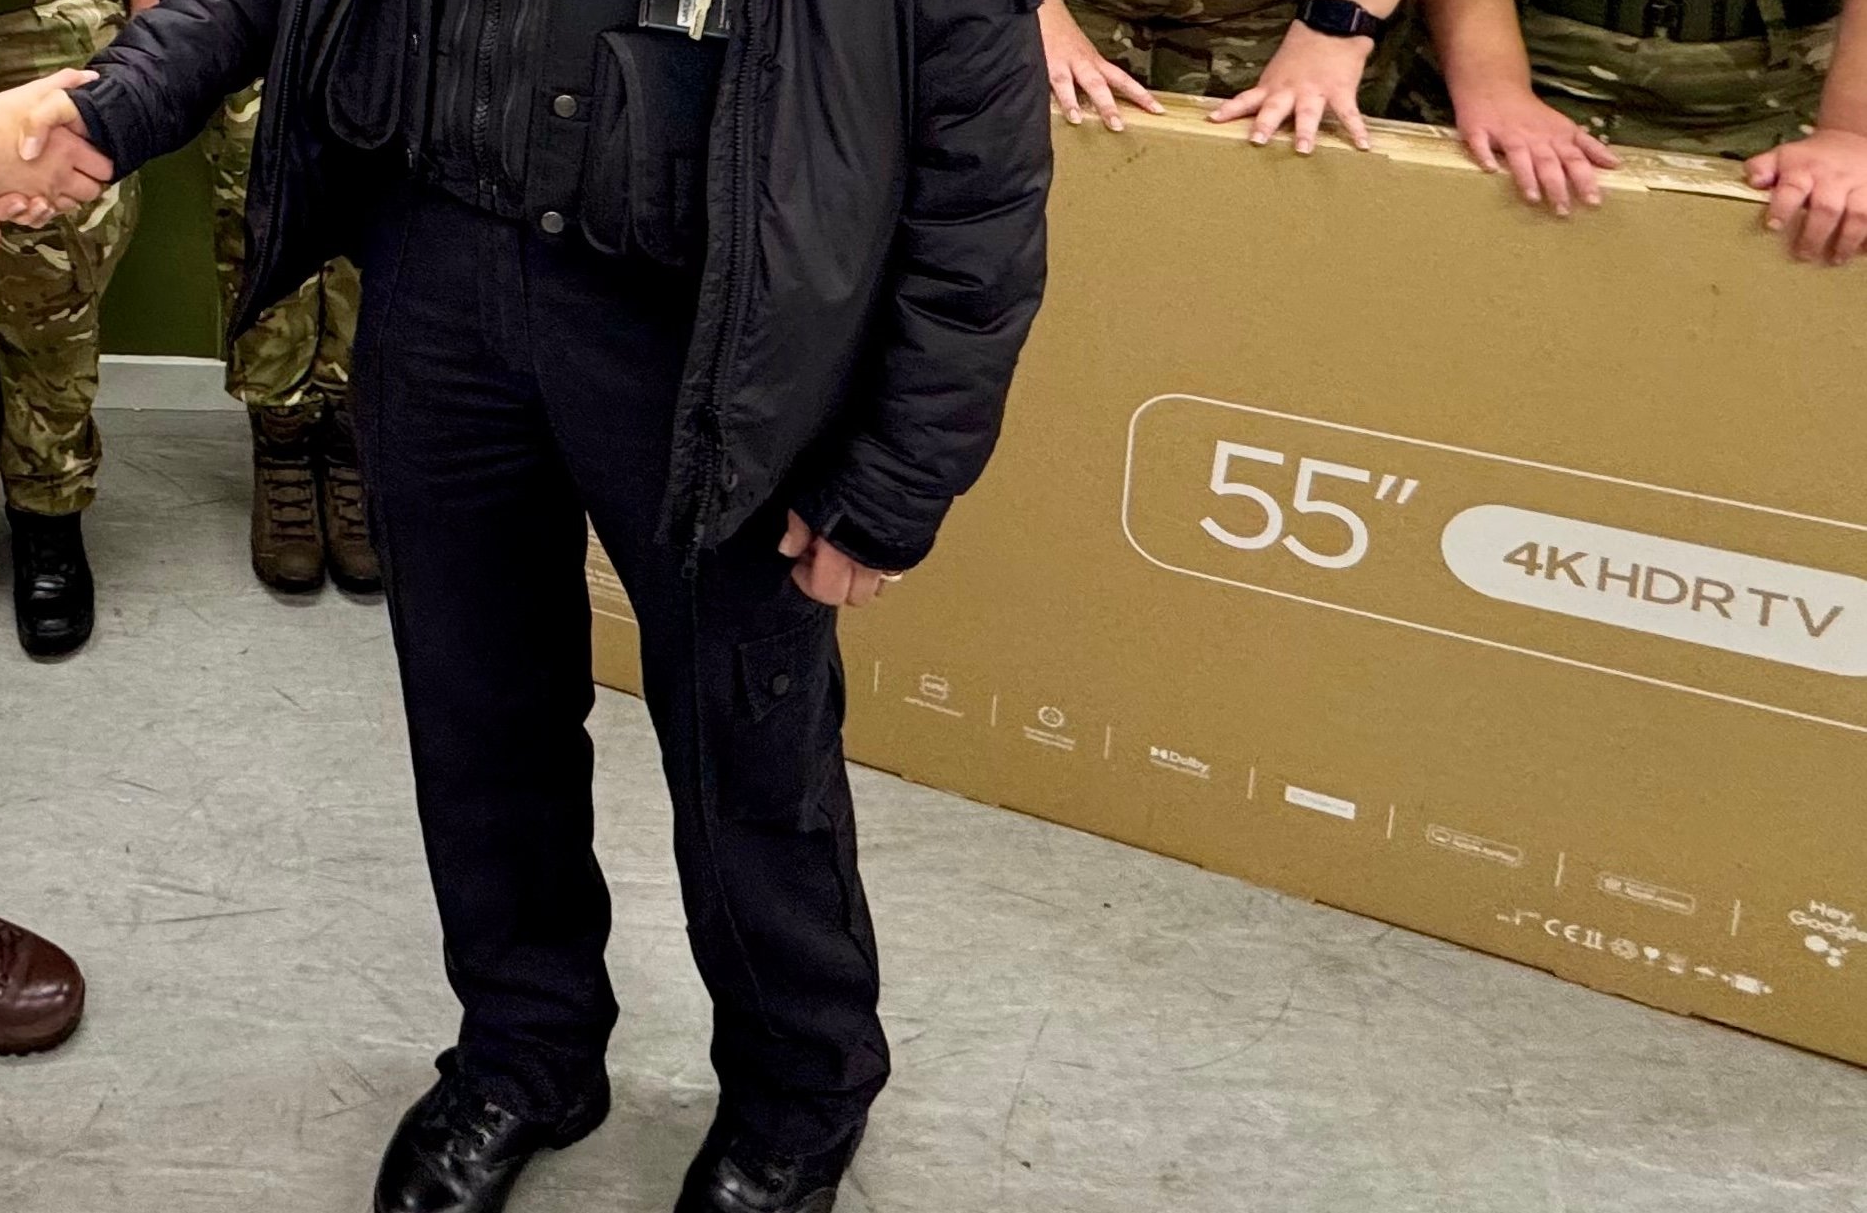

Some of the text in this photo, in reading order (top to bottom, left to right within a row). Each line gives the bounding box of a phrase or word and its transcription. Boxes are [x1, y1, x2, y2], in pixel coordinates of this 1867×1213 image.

[1199, 440, 1420, 569] 55"
[1747, 587, 1845, 638] TV
[1169, 750, 1212, 774] Dolby
[1787, 909, 1867, 943] Google
[1809, 899, 1853, 927] Hey
